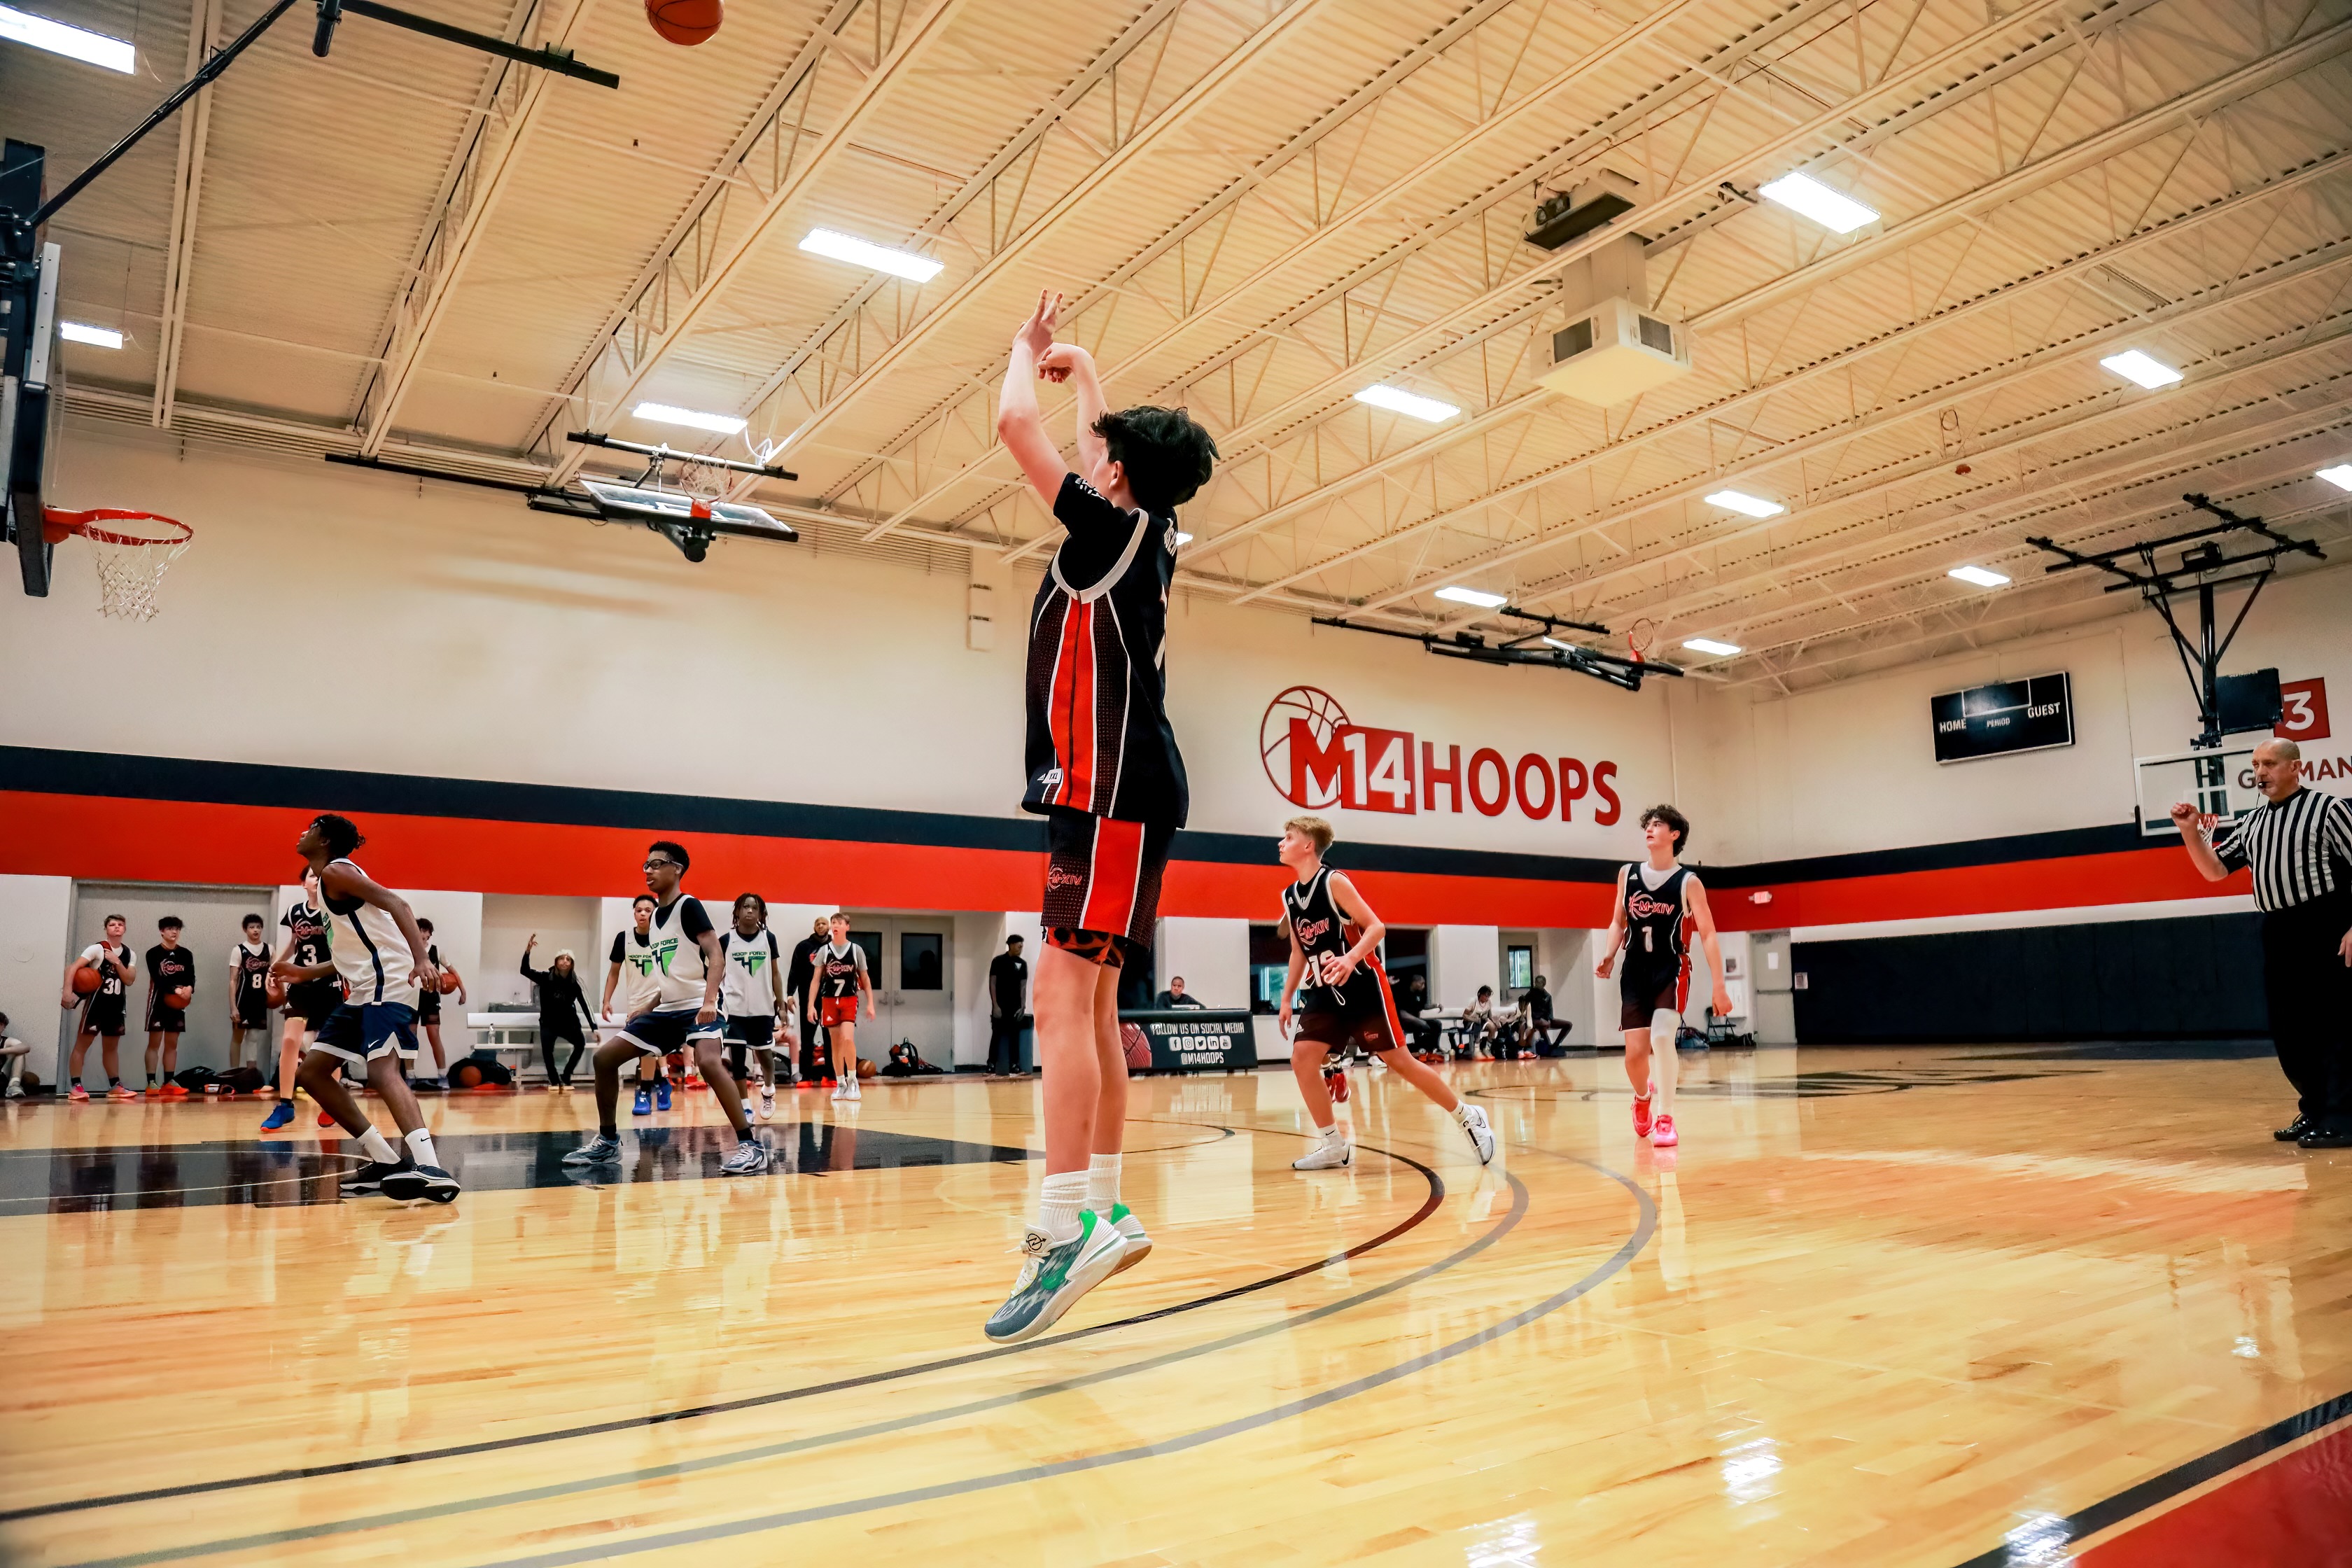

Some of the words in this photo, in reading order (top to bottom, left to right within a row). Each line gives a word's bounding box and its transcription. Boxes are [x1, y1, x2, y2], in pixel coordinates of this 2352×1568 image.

[2027, 702, 2061, 718] GUEST
[2283, 690, 2315, 731] 3
[1939, 718, 1967, 734] HOME
[1639, 900, 1675, 916] M-XIV
[1642, 926, 1653, 953] 1
[302, 944, 318, 966] 3
[103, 978, 122, 995] 30
[252, 973, 262, 989] 8
[834, 979, 846, 997] 7
[1150, 1023, 1178, 1035] FOLLOW
[1180, 1023, 1189, 1035] US
[1190, 1023, 1200, 1035] ON
[1200, 1022, 1224, 1034] SOCIAL
[1225, 1022, 1245, 1033] MEDIA
[1181, 1051, 1224, 1065] @M14HOOPS
